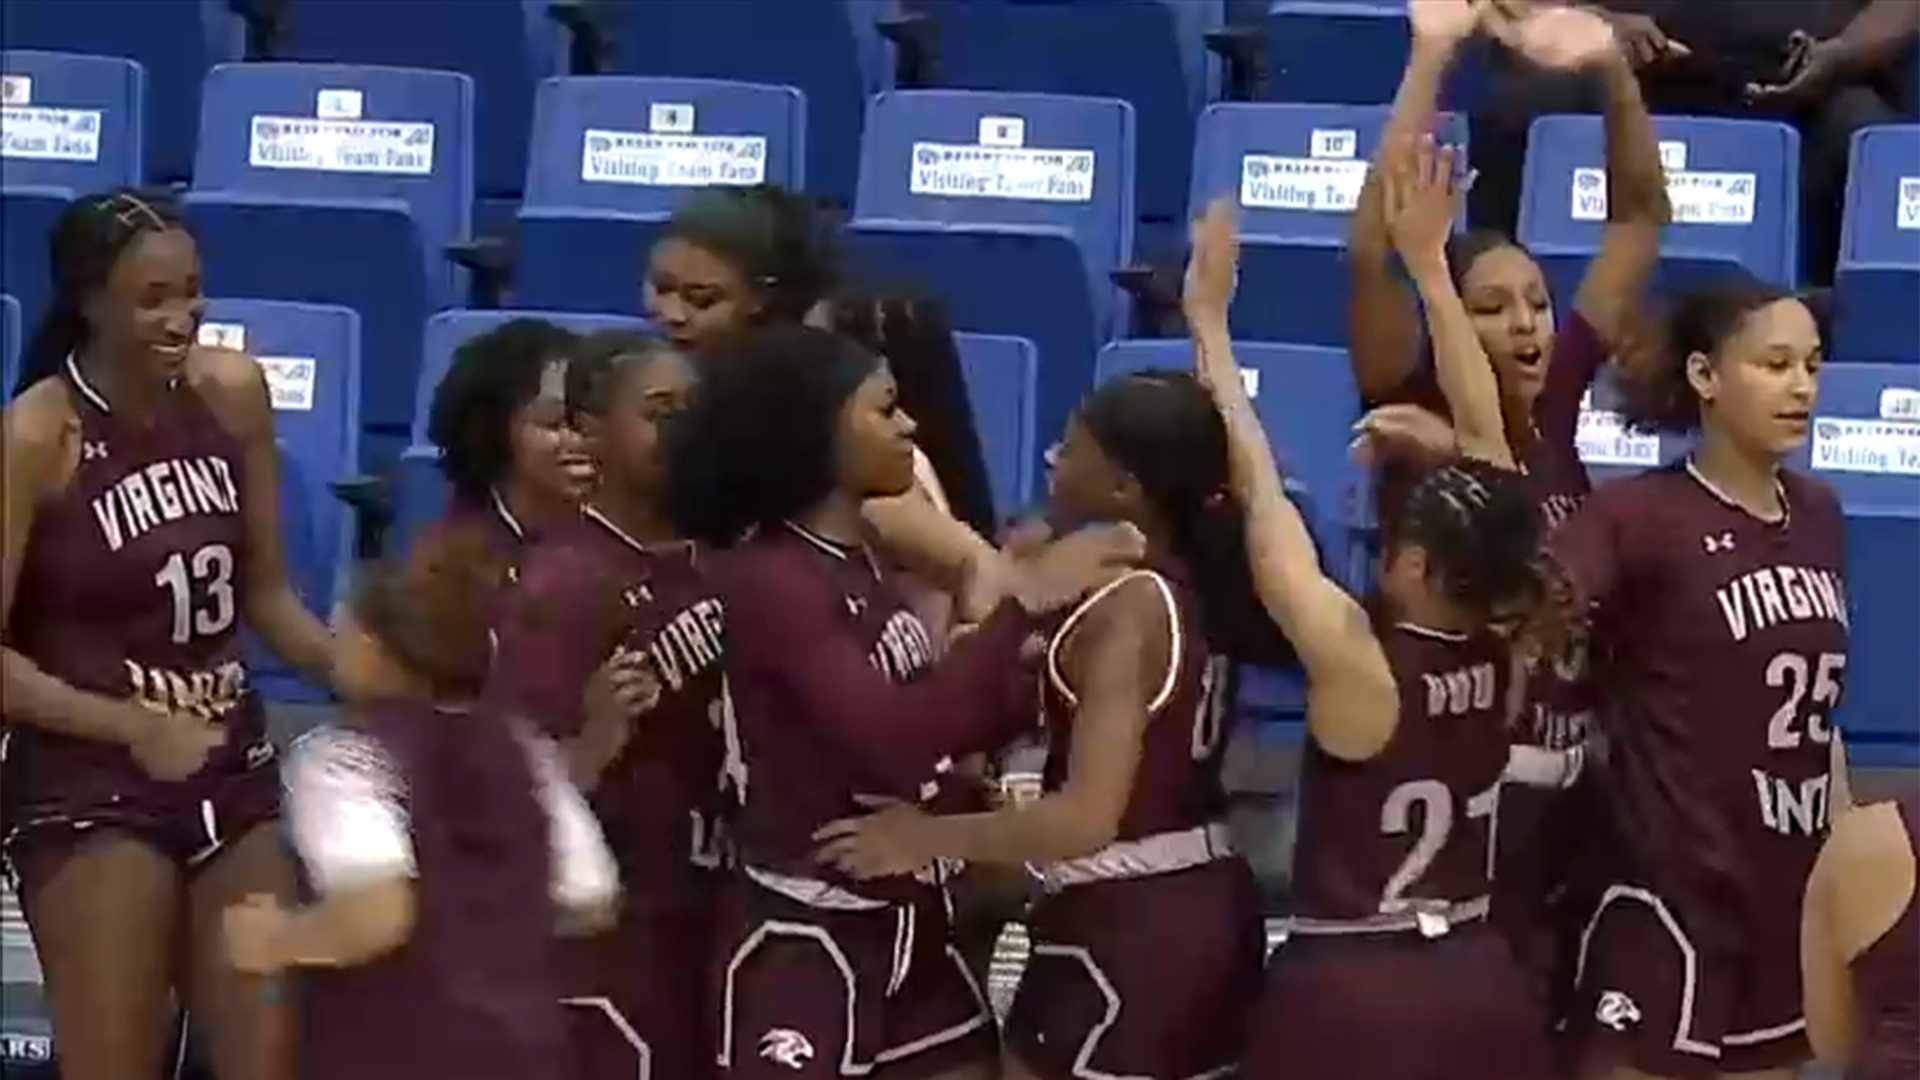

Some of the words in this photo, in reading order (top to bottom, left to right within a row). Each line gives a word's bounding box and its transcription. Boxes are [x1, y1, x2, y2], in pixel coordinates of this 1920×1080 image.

[155, 544, 235, 644] 13
[1765, 652, 1847, 749] 25
[1379, 778, 1500, 914] 21
